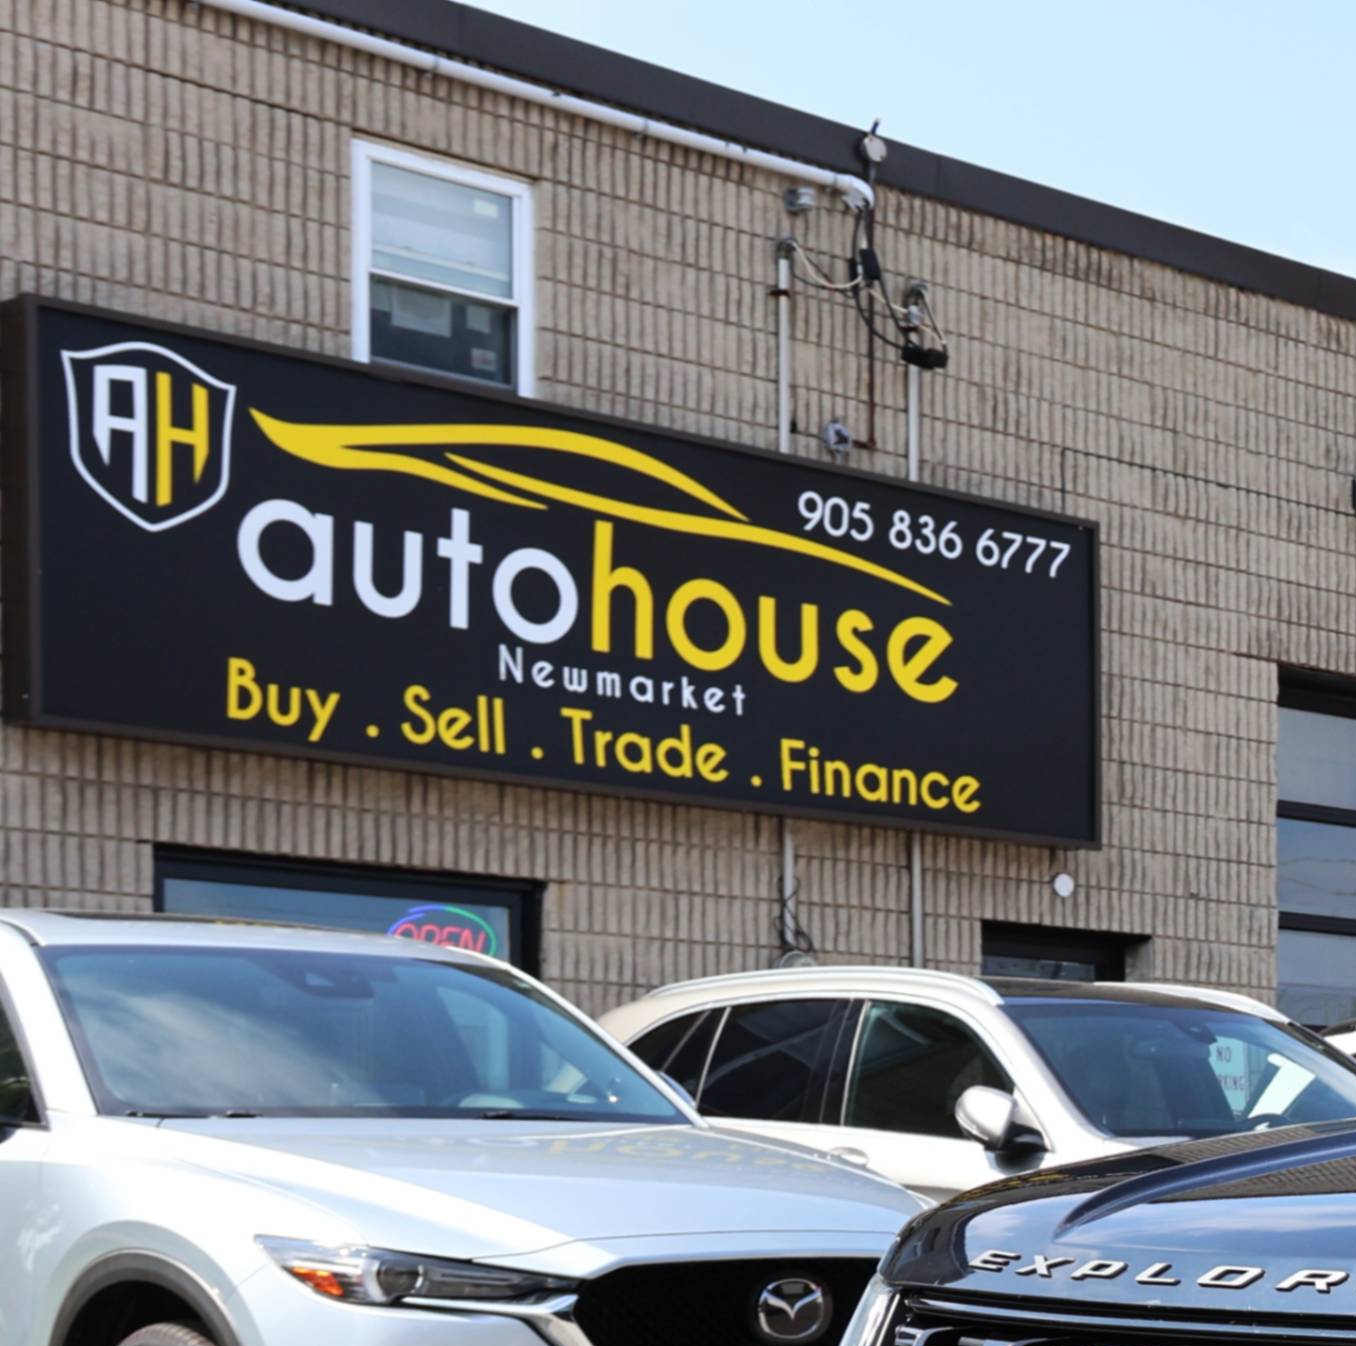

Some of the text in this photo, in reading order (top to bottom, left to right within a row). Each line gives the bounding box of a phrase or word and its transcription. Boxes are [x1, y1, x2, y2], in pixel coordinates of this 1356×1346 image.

[93, 364, 209, 506] AH
[798, 491, 1071, 578] 905 836 6777
[499, 644, 746, 716] Newmarket
[227, 657, 340, 742] Buy
[401, 685, 505, 754] Sell
[560, 707, 729, 782] Trade
[780, 738, 981, 813] Finance
[1215, 1046, 1232, 1063] NO
